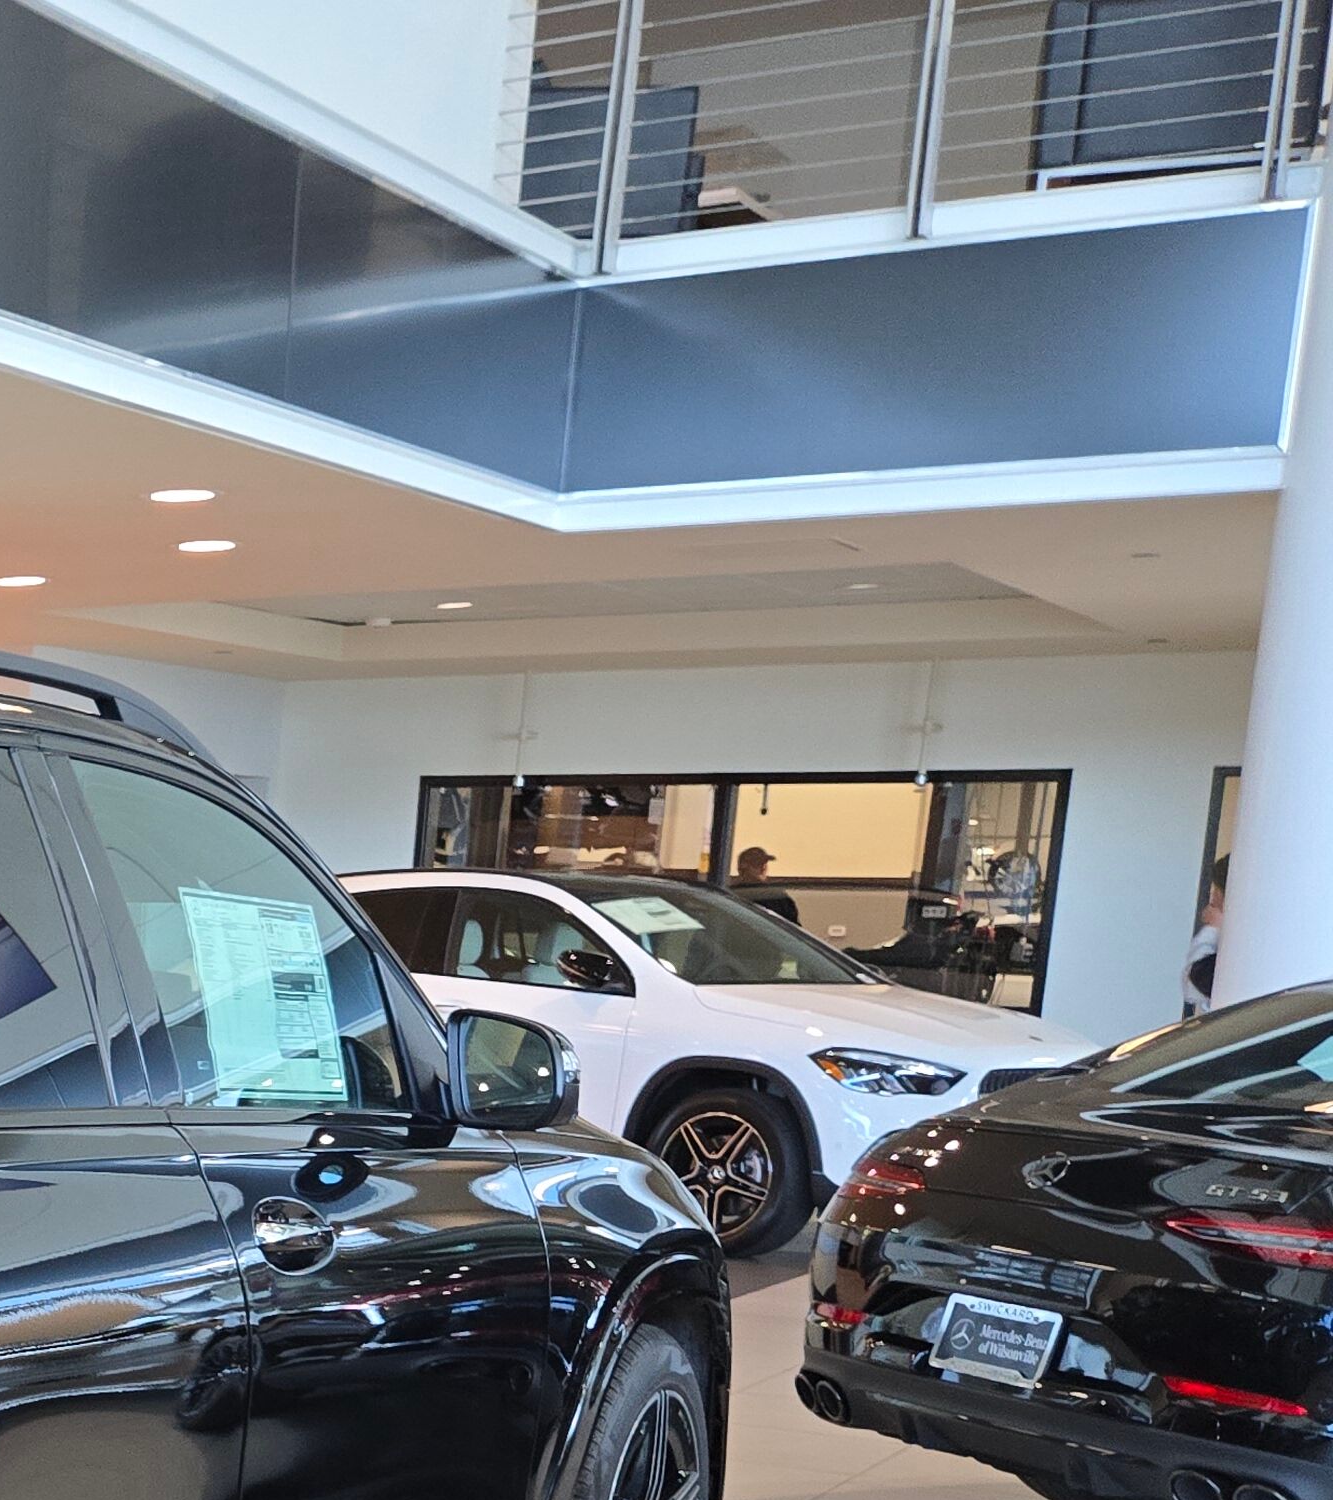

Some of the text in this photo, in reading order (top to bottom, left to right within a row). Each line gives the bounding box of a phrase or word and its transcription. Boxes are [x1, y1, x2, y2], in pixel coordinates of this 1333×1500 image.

[977, 1301, 1034, 1321] SWICKARD
[979, 1324, 1047, 1350] Mercedes-Benz
[989, 1341, 1040, 1366] Wilsonville
